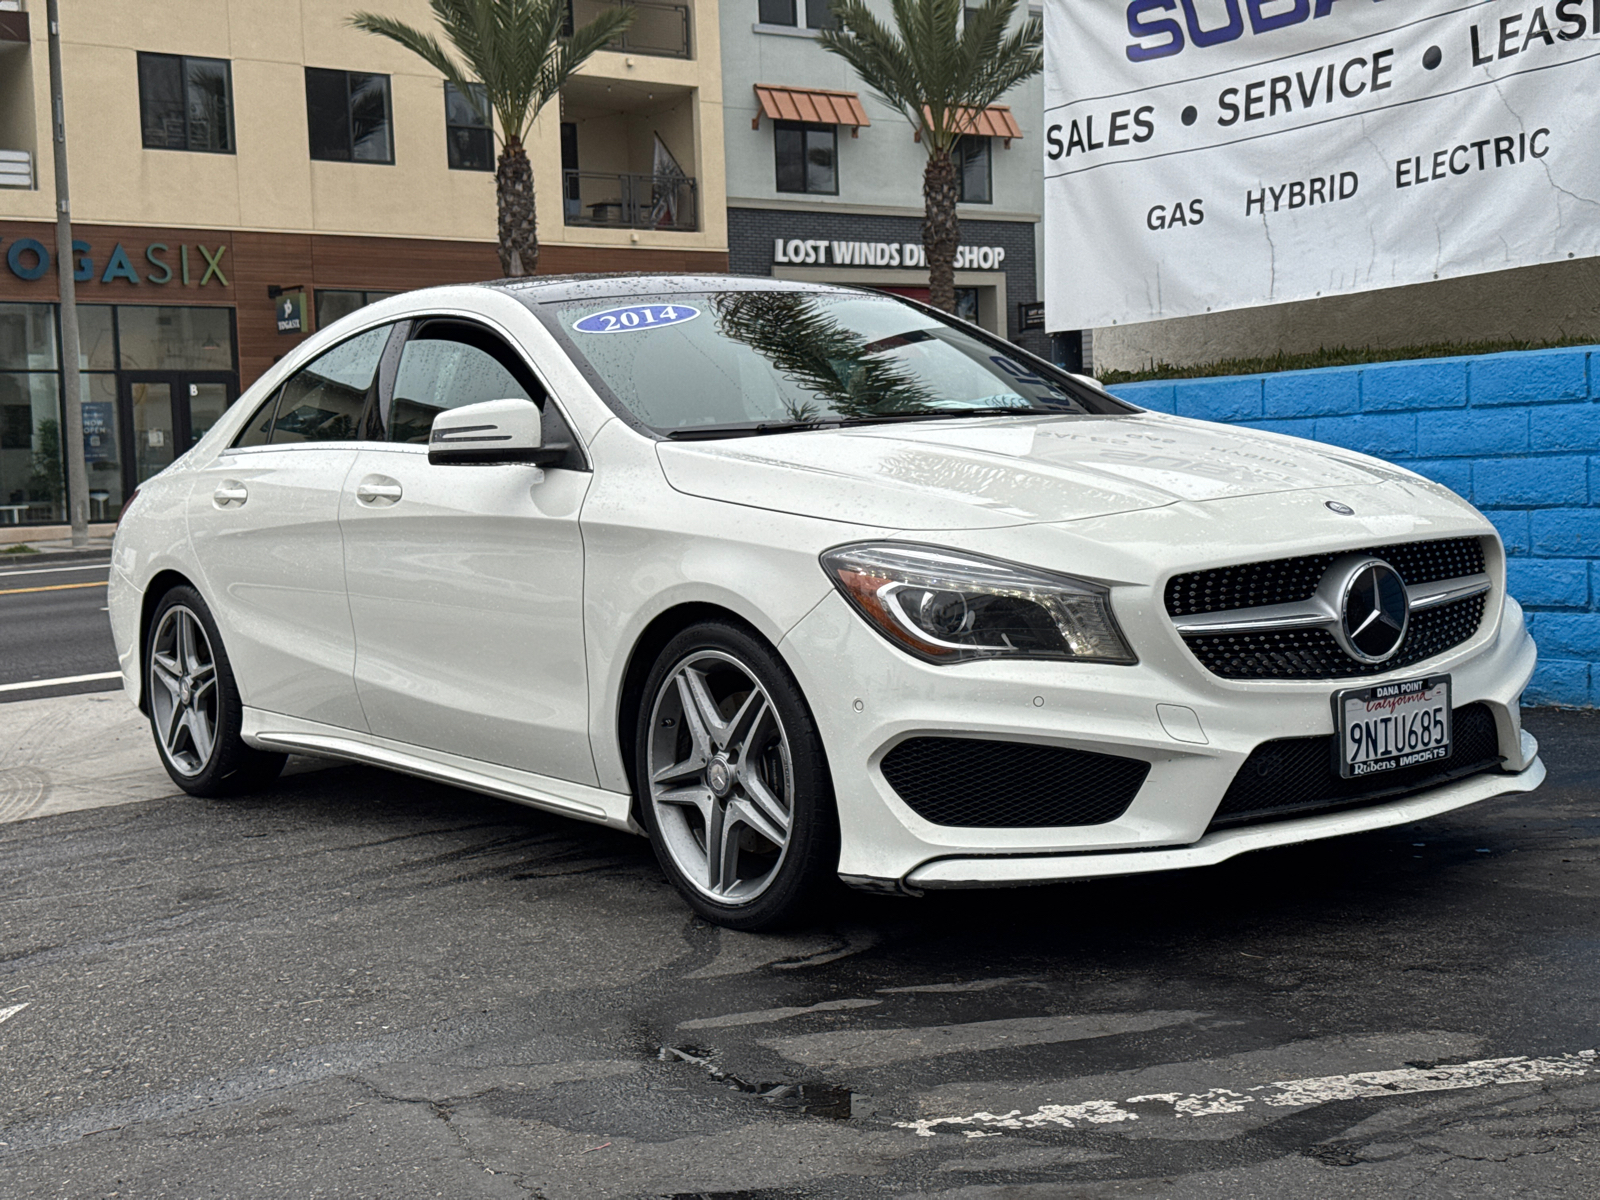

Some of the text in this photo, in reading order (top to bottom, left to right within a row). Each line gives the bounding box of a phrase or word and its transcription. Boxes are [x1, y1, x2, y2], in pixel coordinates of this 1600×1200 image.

[1047, 105, 1154, 161] SALES
[1217, 48, 1394, 127] SERVICE
[1396, 128, 1551, 188] ELECTRIC
[1246, 171, 1359, 216] HYBRID
[1147, 199, 1204, 230] GAS
[0, 237, 229, 287] OGASIX
[774, 239, 829, 264] LOST
[831, 241, 900, 267] WINDS
[952, 246, 1005, 269] SHOP
[600, 306, 677, 331] 2014
[1366, 691, 1432, 714] California
[1376, 681, 1423, 698] DANA POINT
[1350, 707, 1444, 761] 9NIU685
[1353, 747, 1446, 775] Rubens IMPORTS
